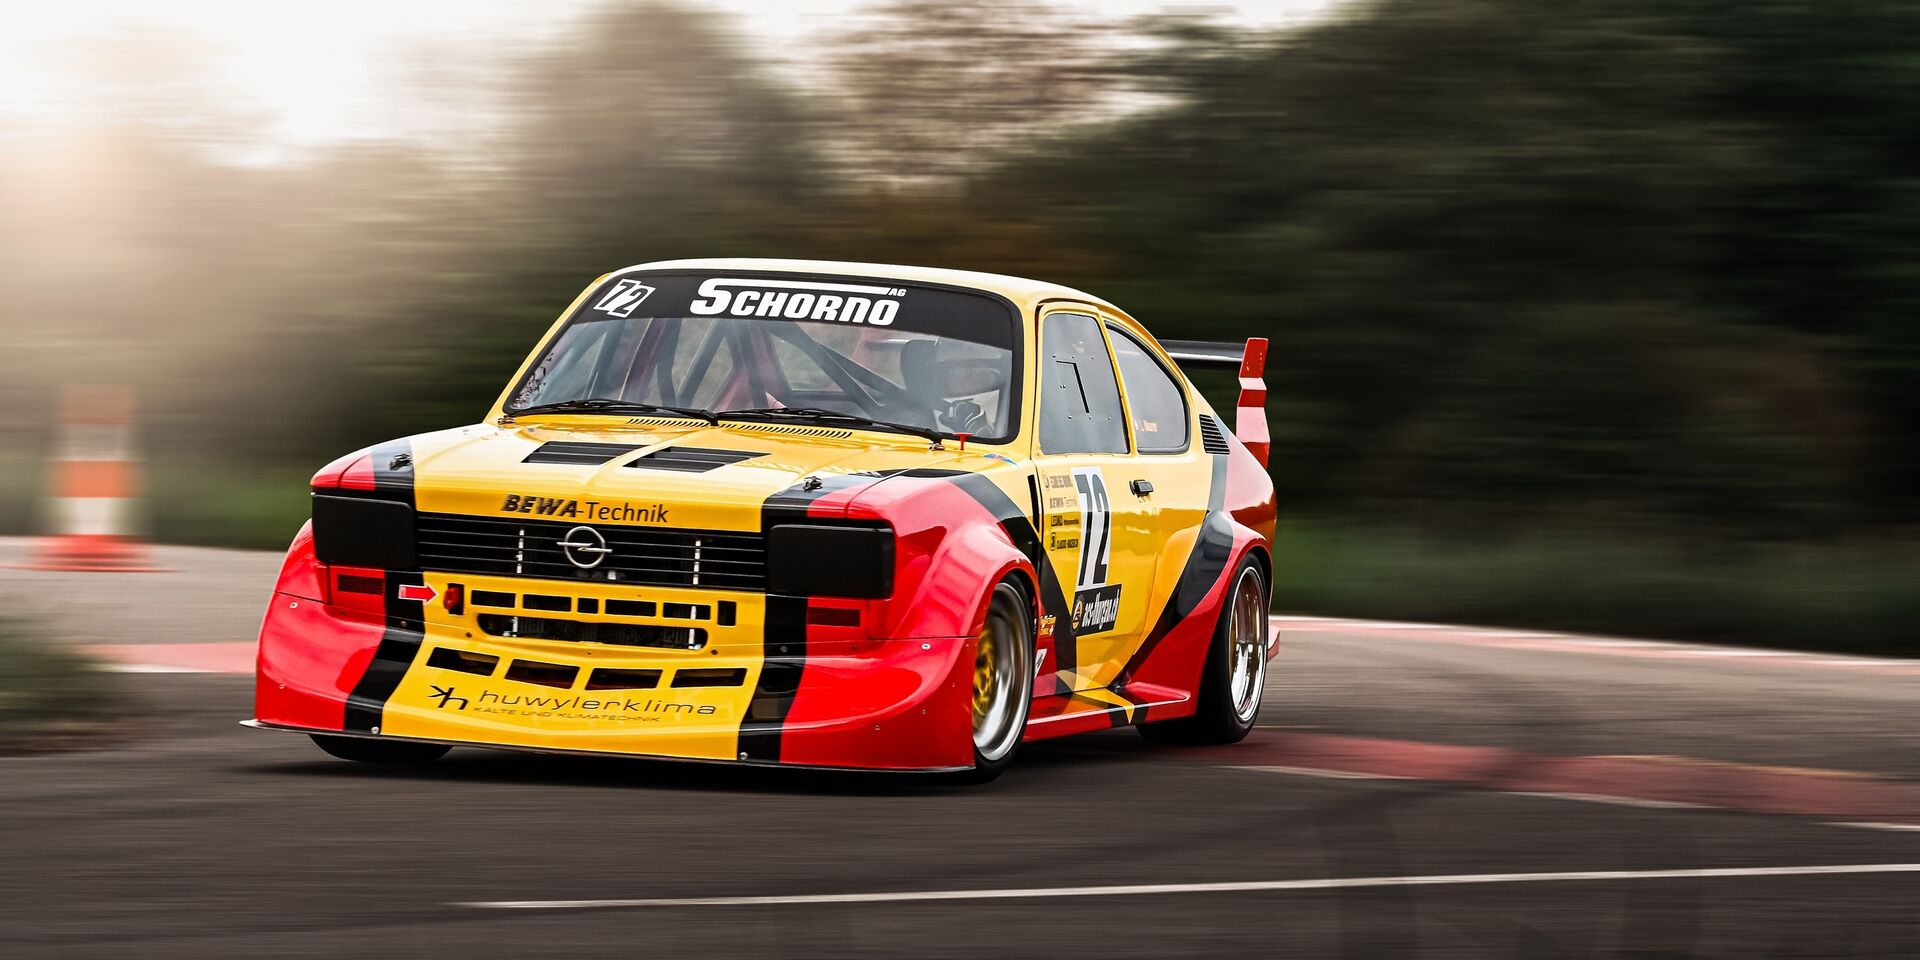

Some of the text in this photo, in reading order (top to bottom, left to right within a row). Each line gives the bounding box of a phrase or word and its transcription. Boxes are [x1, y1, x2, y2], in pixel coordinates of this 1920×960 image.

[597, 280, 650, 316] 72
[689, 277, 900, 326] SCHORNO
[887, 281, 907, 297] AG
[500, 493, 670, 523] BEWA-Technik
[1074, 474, 1110, 586] 72
[479, 689, 717, 715] huwylerklima
[520, 709, 553, 718] UND
[556, 711, 661, 722] KLIMATECHNIK
